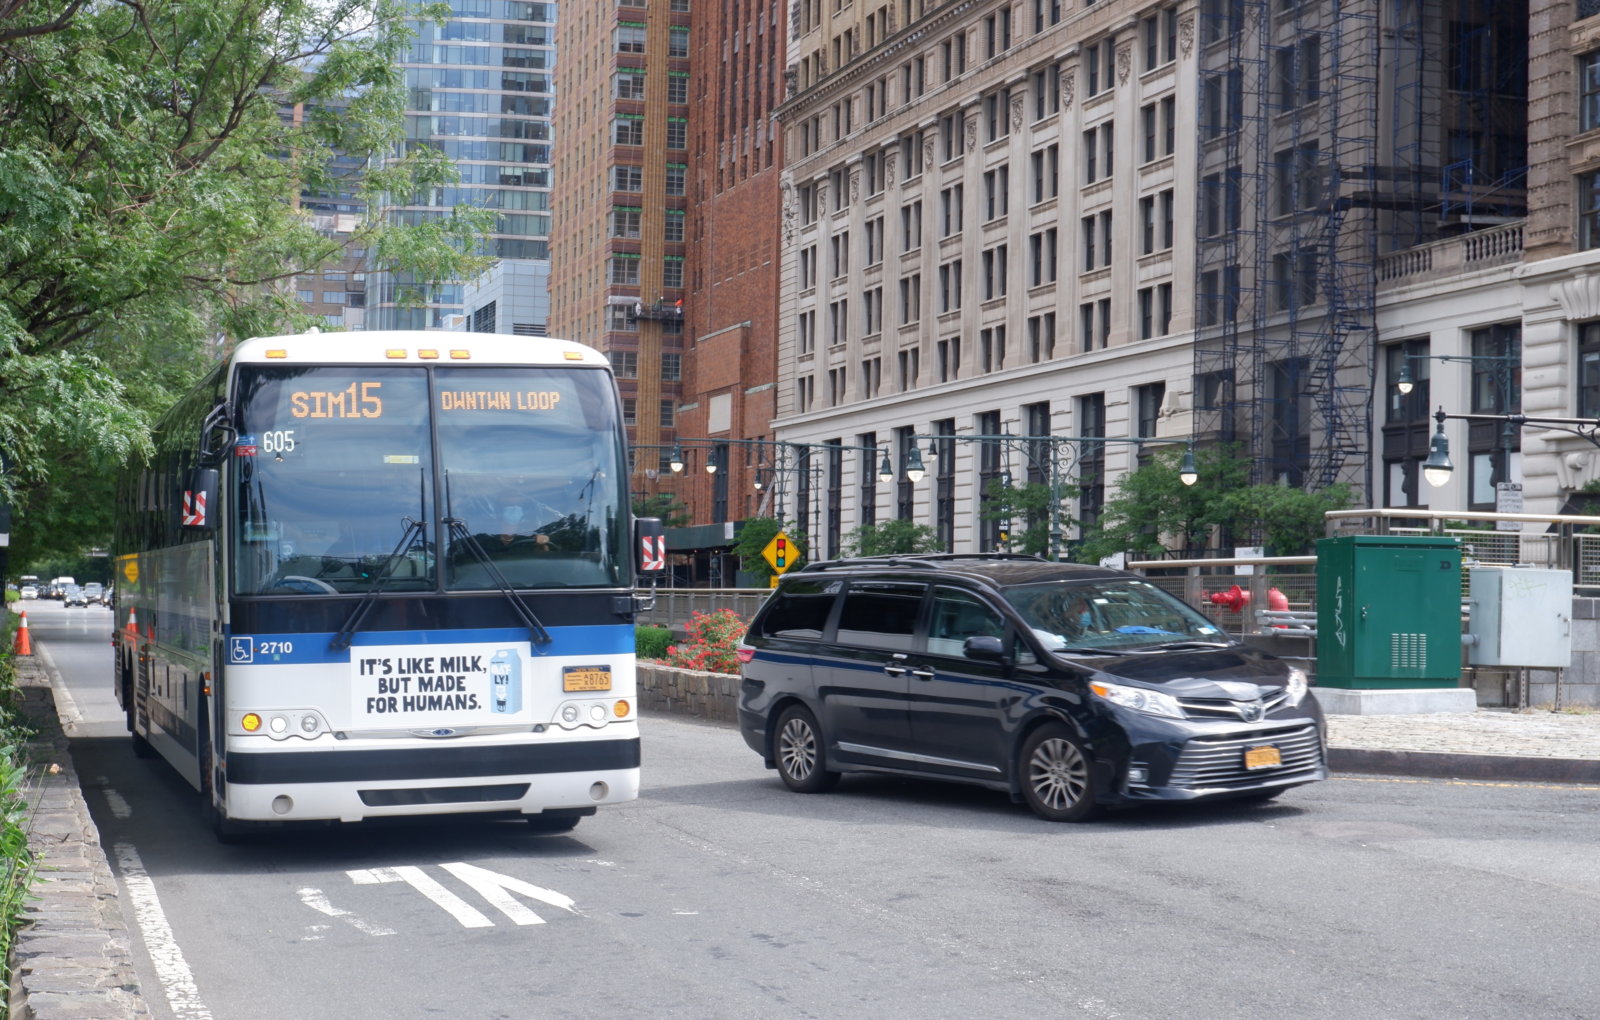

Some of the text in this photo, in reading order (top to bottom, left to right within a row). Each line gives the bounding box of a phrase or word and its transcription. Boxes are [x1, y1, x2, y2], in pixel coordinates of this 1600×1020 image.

[291, 381, 382, 418] SIM15
[441, 391, 561, 410] DWNTWN LOOP
[263, 430, 295, 453] 605
[260, 641, 293, 654] 2710
[360, 655, 487, 675] IT'S LIKE MILK,
[378, 675, 466, 694] BUT MADE
[366, 693, 482, 714] FOR HUMANS.
